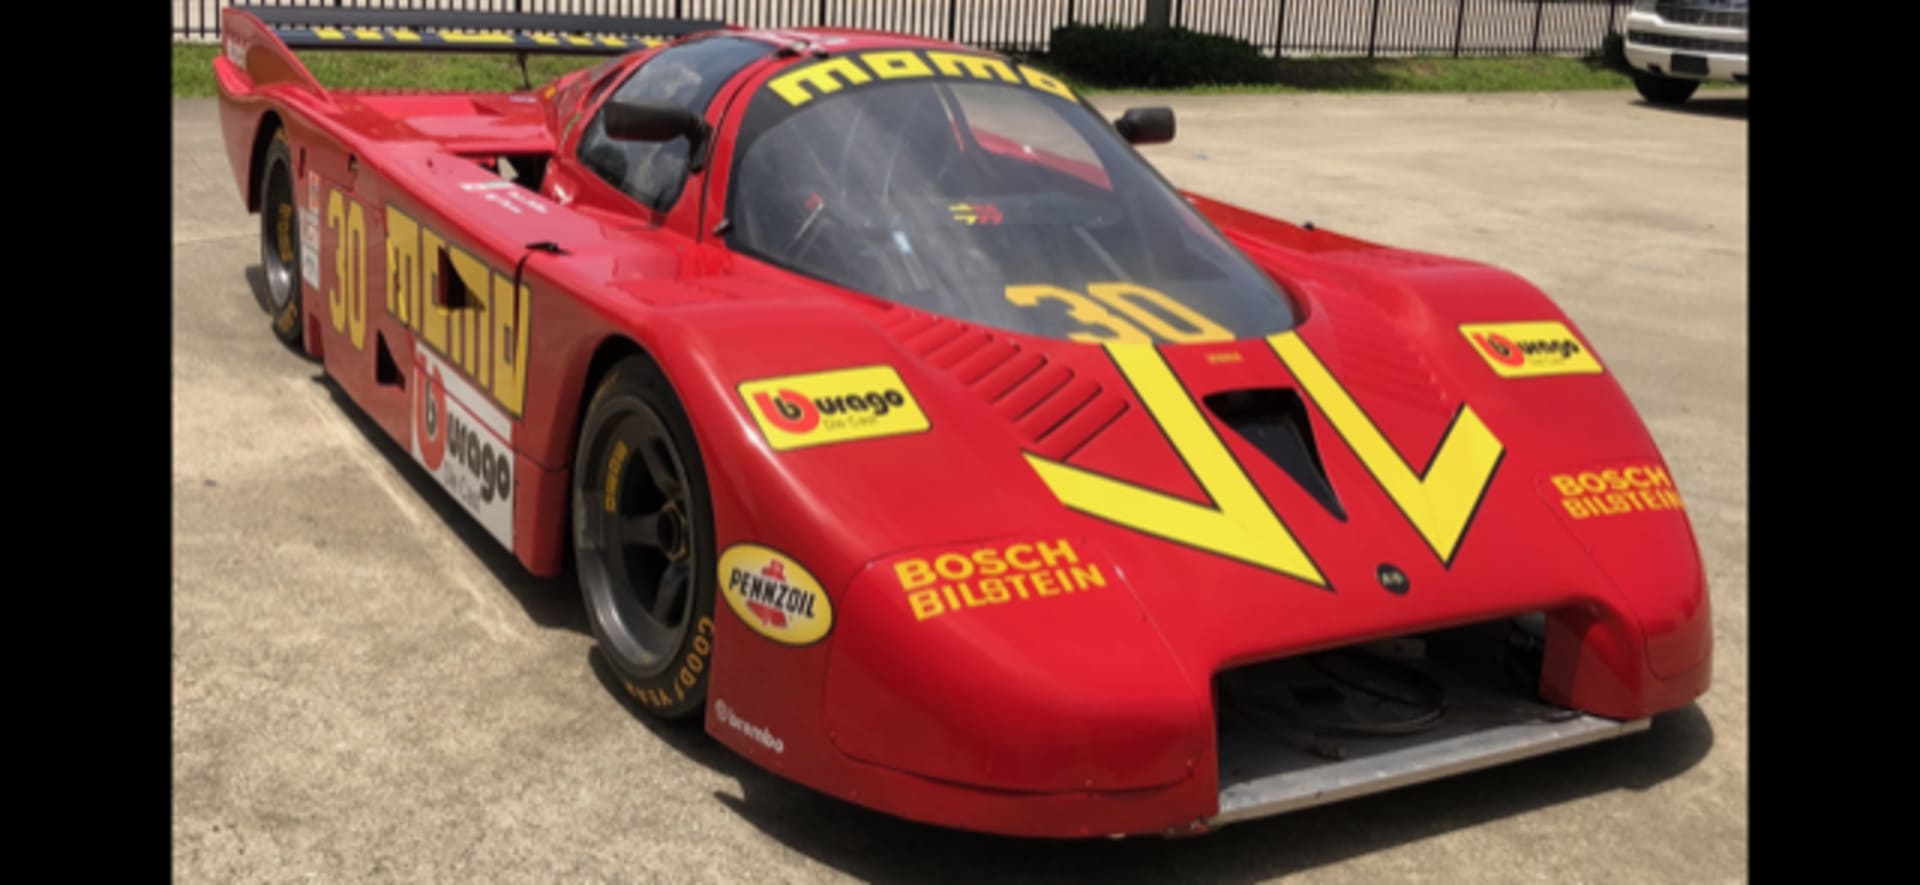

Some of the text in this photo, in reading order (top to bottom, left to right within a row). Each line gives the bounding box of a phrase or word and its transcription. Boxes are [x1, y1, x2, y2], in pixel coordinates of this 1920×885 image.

[326, 187, 367, 351] 30
[1004, 281, 1236, 345] 30
[752, 388, 905, 434] burago
[1550, 465, 1672, 497] BOSCH
[893, 538, 1079, 592] BOSCH
[729, 567, 817, 619] PENNZOIL
[907, 563, 1107, 622] BILSTEIN
[727, 705, 784, 755] brembo
